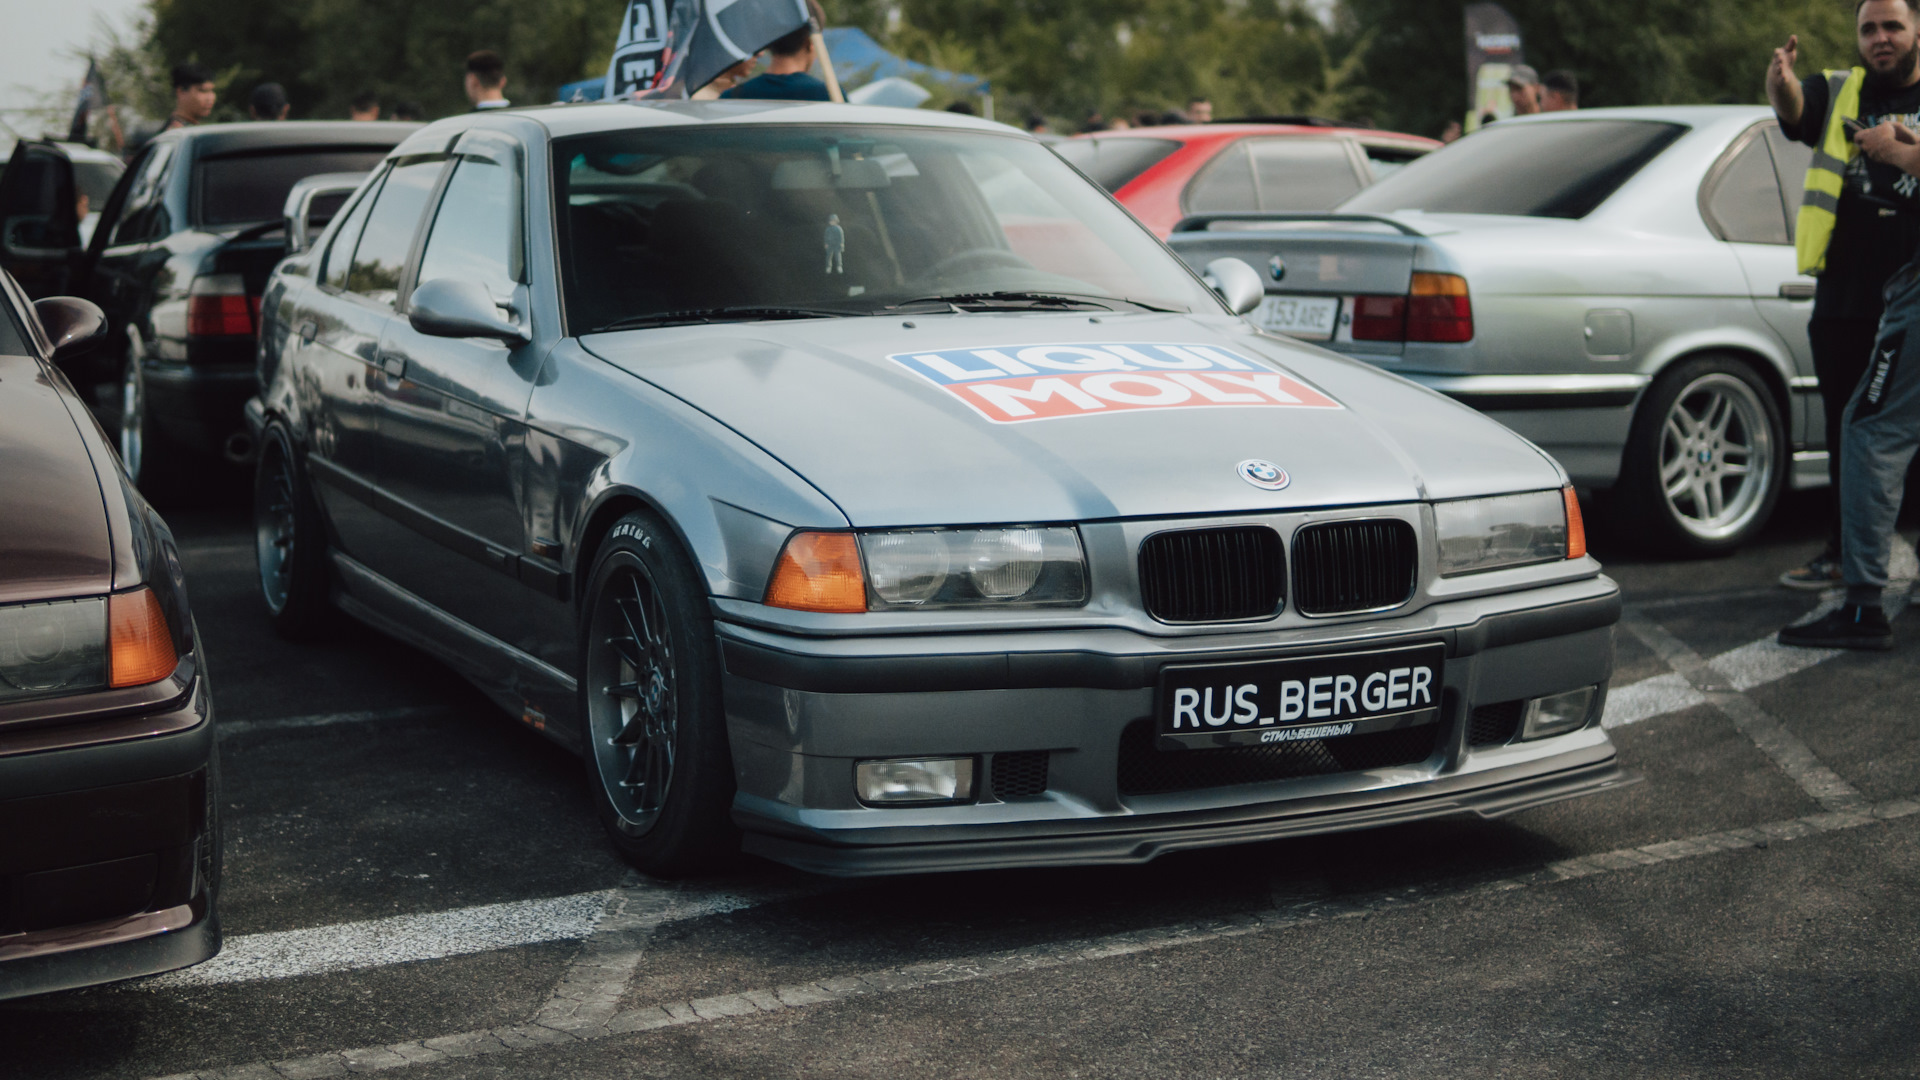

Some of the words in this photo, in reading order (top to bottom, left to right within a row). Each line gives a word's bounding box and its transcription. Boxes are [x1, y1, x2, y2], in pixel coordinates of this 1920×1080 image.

[1264, 300, 1298, 326] 153
[912, 345, 1254, 381] LIQUI
[967, 373, 1303, 417] MOLY
[1173, 666, 1432, 728] RUS_BERGER
[1260, 722, 1353, 743] СТИЛЬБЕШЕНЫЙ
